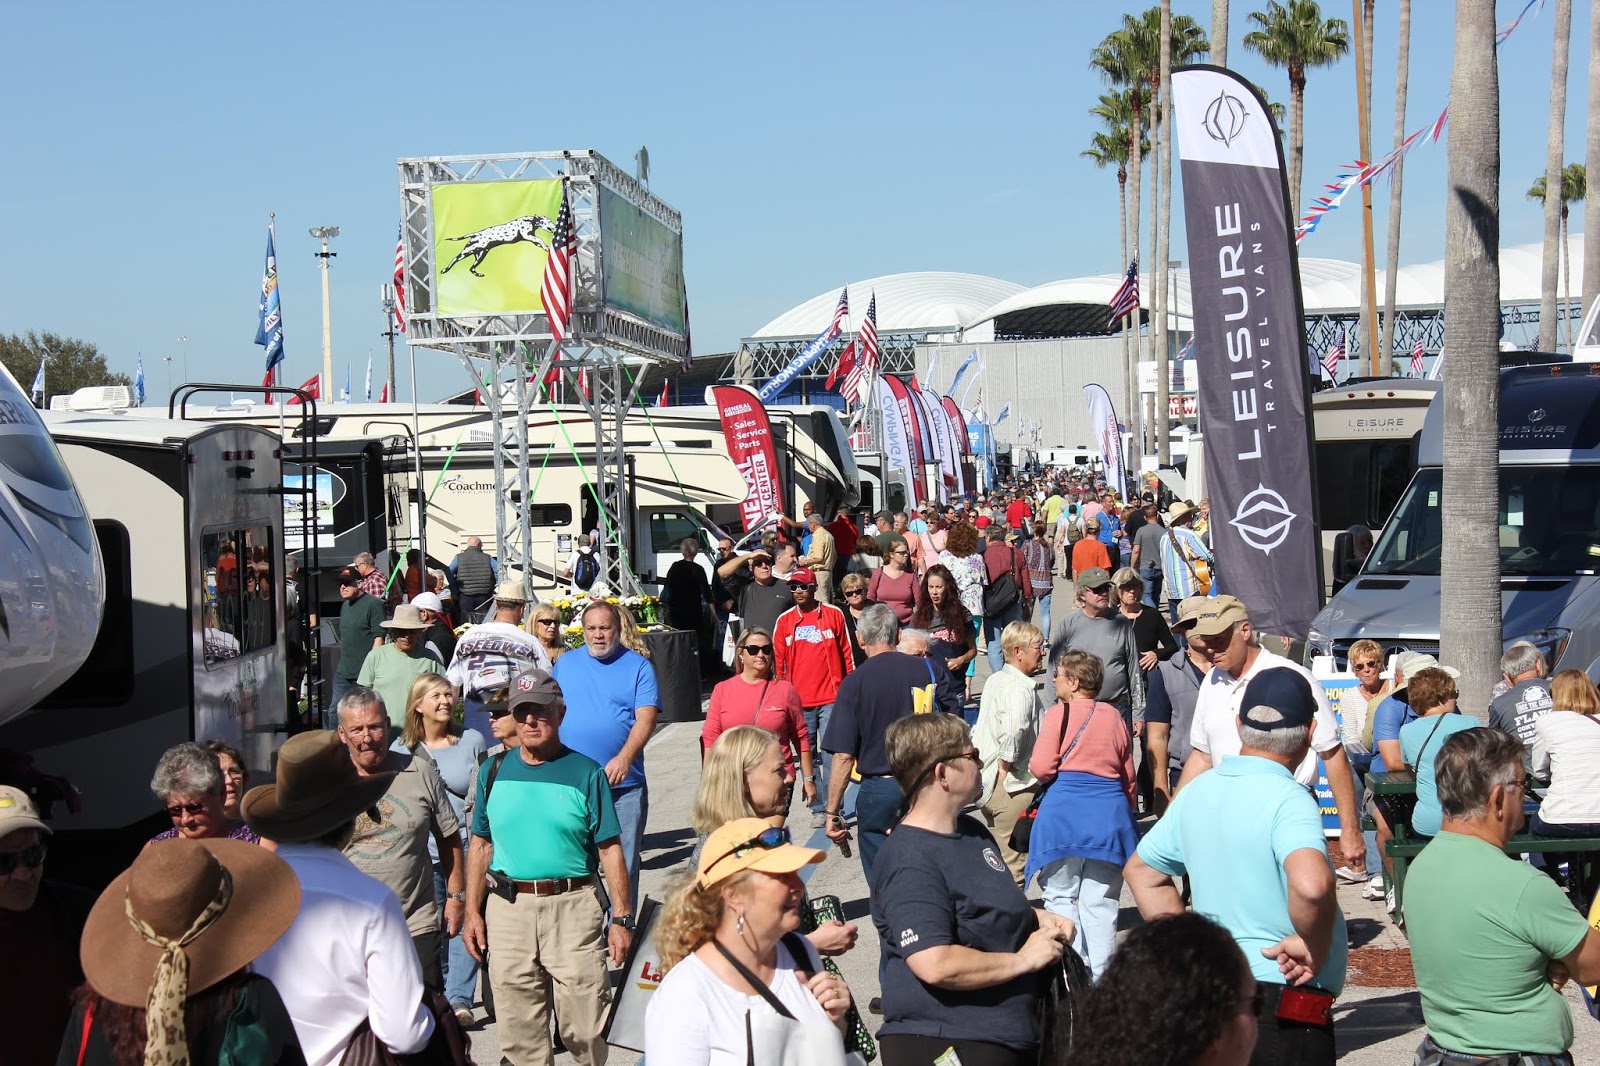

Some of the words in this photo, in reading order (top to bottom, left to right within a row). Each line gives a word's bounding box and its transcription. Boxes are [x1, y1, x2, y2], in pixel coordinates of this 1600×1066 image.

[1251, 221, 1266, 297] VANS
[1214, 203, 1262, 460] LEISURE
[791, 331, 831, 367] AMPING
[1258, 316, 1277, 432] TRAVEL
[760, 366, 798, 399] WORLD
[734, 420, 756, 430] Sales
[1348, 418, 1404, 427] LEISURE
[736, 428, 767, 440] Service
[738, 440, 760, 450] Parts
[448, 481, 496, 490] Coachm
[755, 459, 771, 500] CENTER
[468, 653, 486, 670] 2
[1517, 724, 1536, 732] CONV
[900, 934, 919, 948] KUIU
